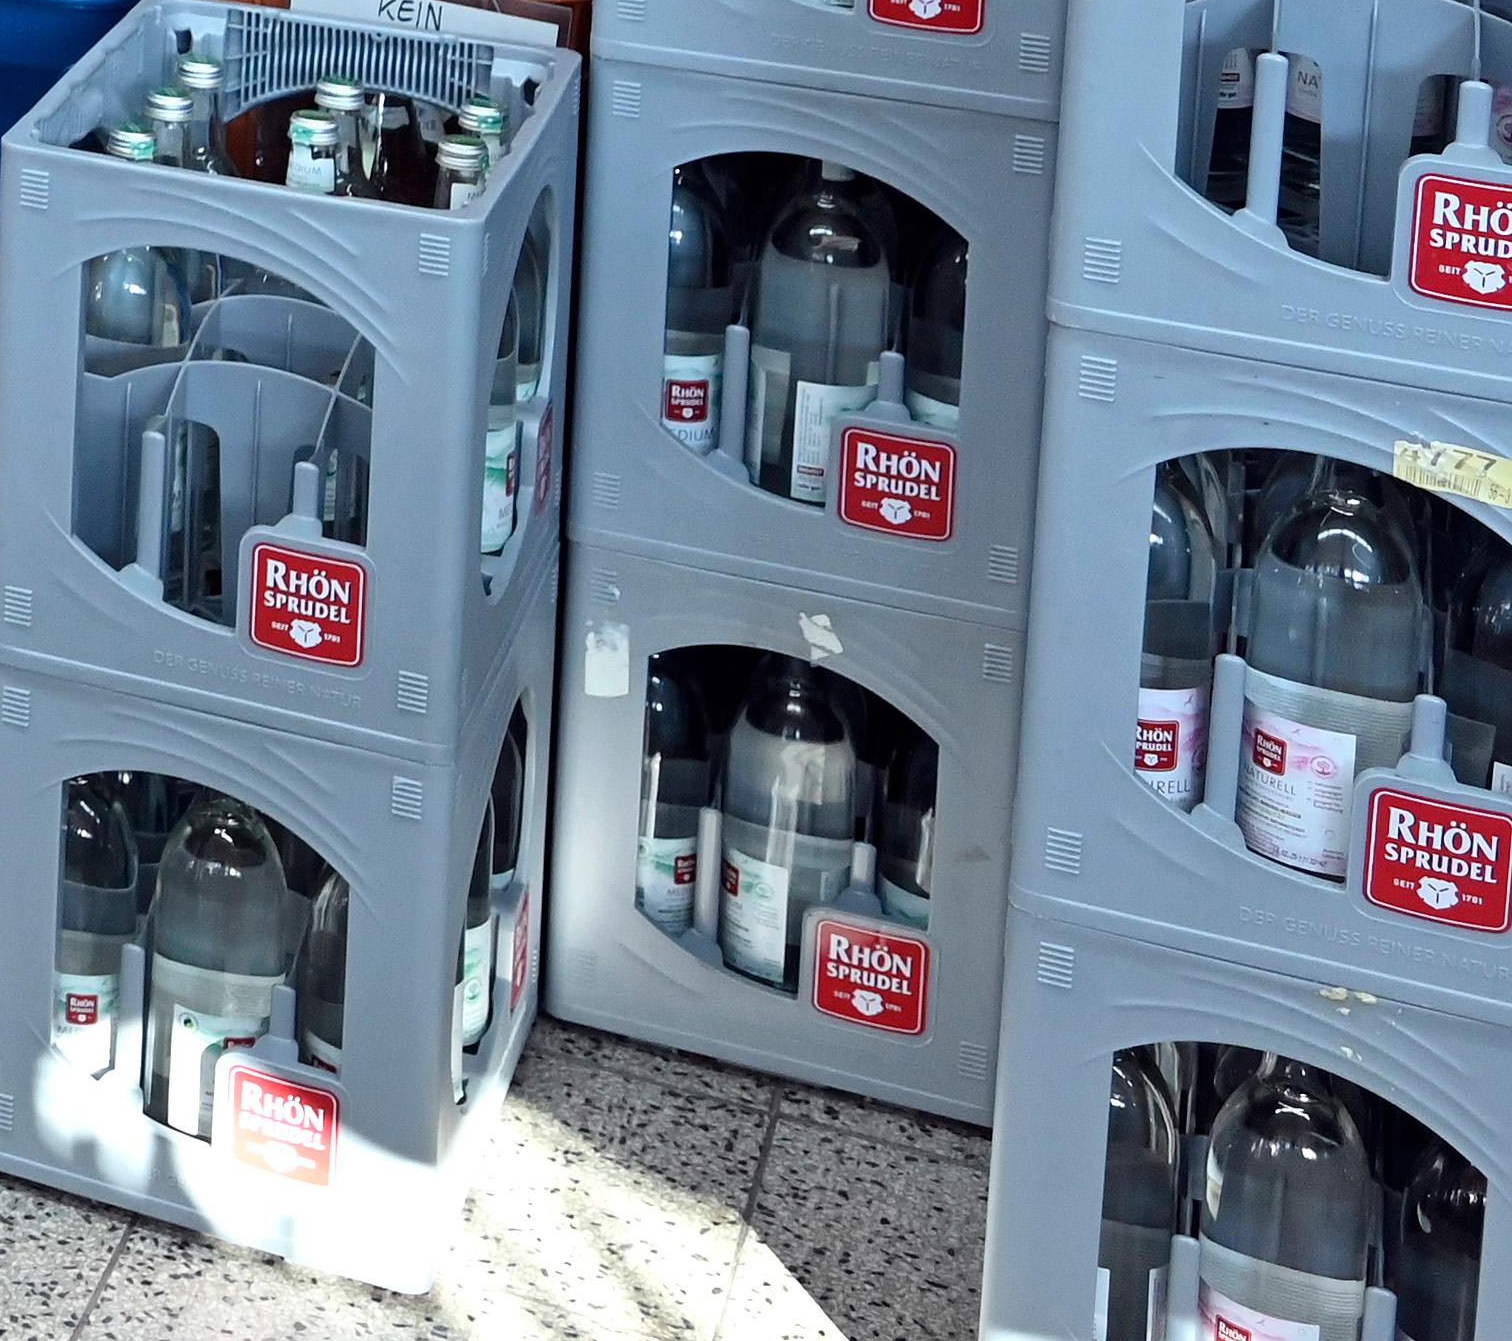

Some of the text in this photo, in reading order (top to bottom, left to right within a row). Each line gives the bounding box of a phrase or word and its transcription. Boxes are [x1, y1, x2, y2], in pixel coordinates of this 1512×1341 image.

[1297, 70, 1320, 89] NA
[854, 441, 942, 484] RHÖN
[853, 471, 942, 502] SPRUDEL
[266, 558, 351, 605] RHÖN
[263, 590, 351, 625] SPRUDEL
[1387, 805, 1500, 863] RHÖN
[1383, 841, 1498, 885] SPRUDEL
[829, 933, 913, 978] RHÖN
[826, 961, 913, 996] SPRUDEL
[241, 1080, 325, 1133] RHÖN
